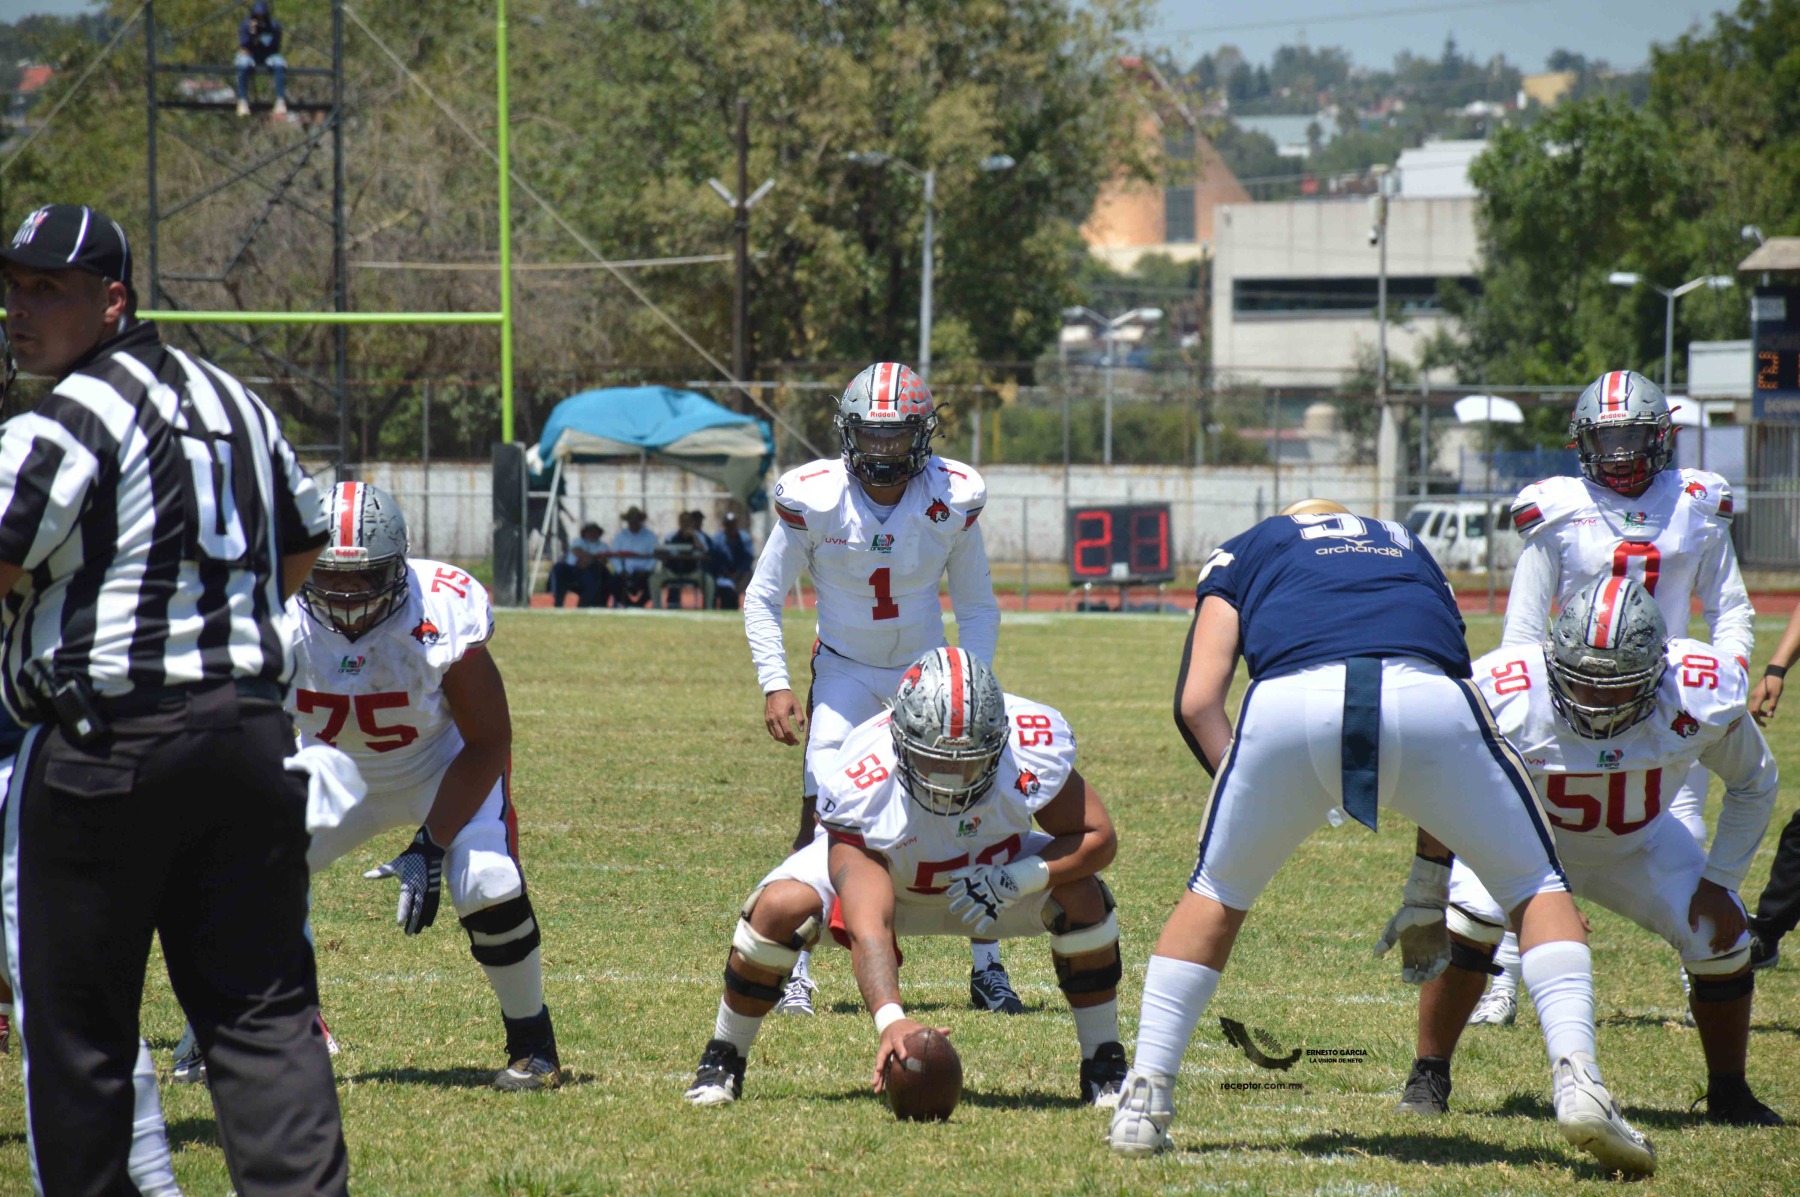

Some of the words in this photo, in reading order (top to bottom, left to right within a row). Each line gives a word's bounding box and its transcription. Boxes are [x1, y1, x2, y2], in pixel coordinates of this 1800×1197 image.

[179, 435, 247, 561] U
[825, 537, 847, 545] UVM
[431, 567, 471, 599] 75
[868, 567, 899, 621] 1
[1490, 659, 1532, 696] 50
[1681, 653, 1719, 690] 50
[296, 688, 419, 753] 75
[1016, 714, 1054, 748] 58
[845, 752, 889, 790] 58
[1523, 757, 1546, 766] VM
[1545, 767, 1664, 836] 50
